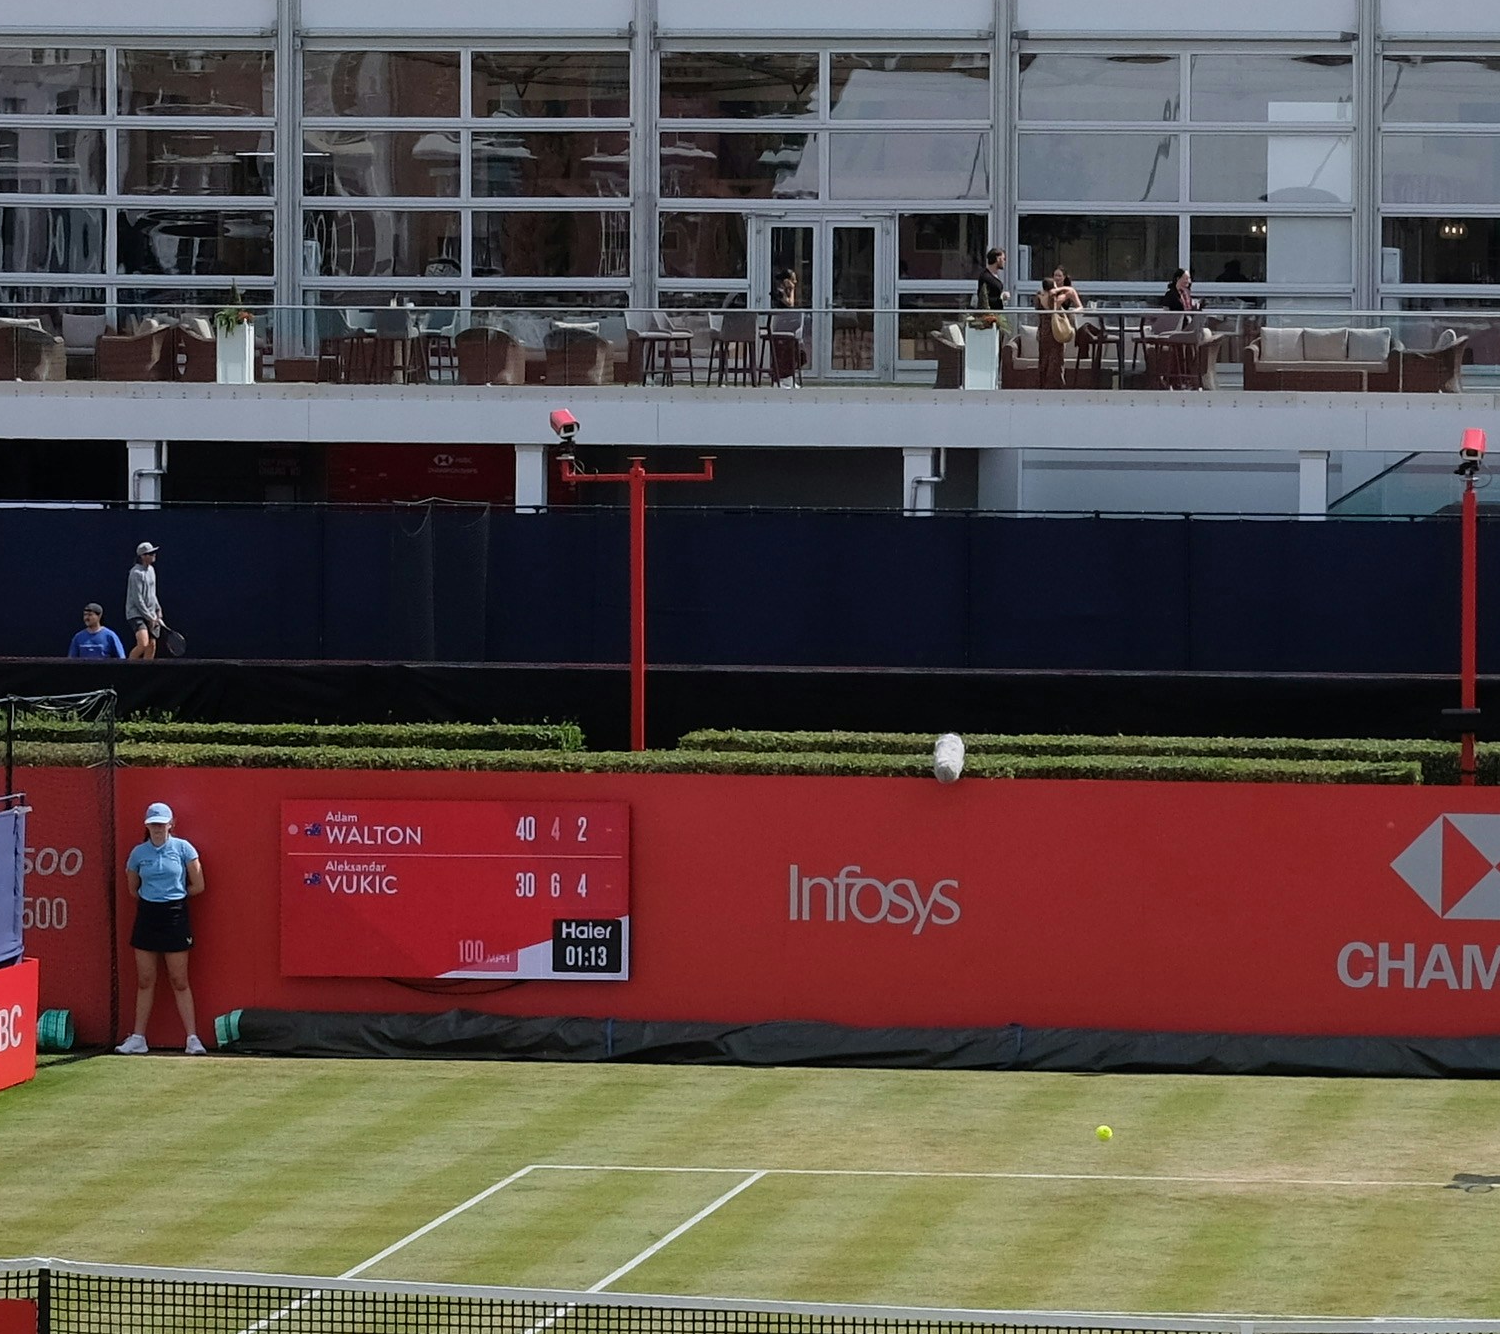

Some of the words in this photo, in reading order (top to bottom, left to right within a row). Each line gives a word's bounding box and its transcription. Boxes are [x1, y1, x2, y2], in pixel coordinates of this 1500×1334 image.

[325, 811, 358, 823] Adam
[325, 826, 422, 846] WALTON
[515, 817, 536, 841] 40
[551, 817, 561, 841] 4
[577, 817, 587, 842] 2
[325, 860, 387, 873] Aleksandar
[325, 874, 398, 895] VUKIC
[515, 873, 536, 898] 30
[550, 872, 561, 898] 6
[577, 873, 587, 898] 4
[789, 864, 961, 936] Infosys
[562, 922, 613, 940] Haier
[458, 939, 484, 964] 100
[565, 945, 608, 967] 01:13
